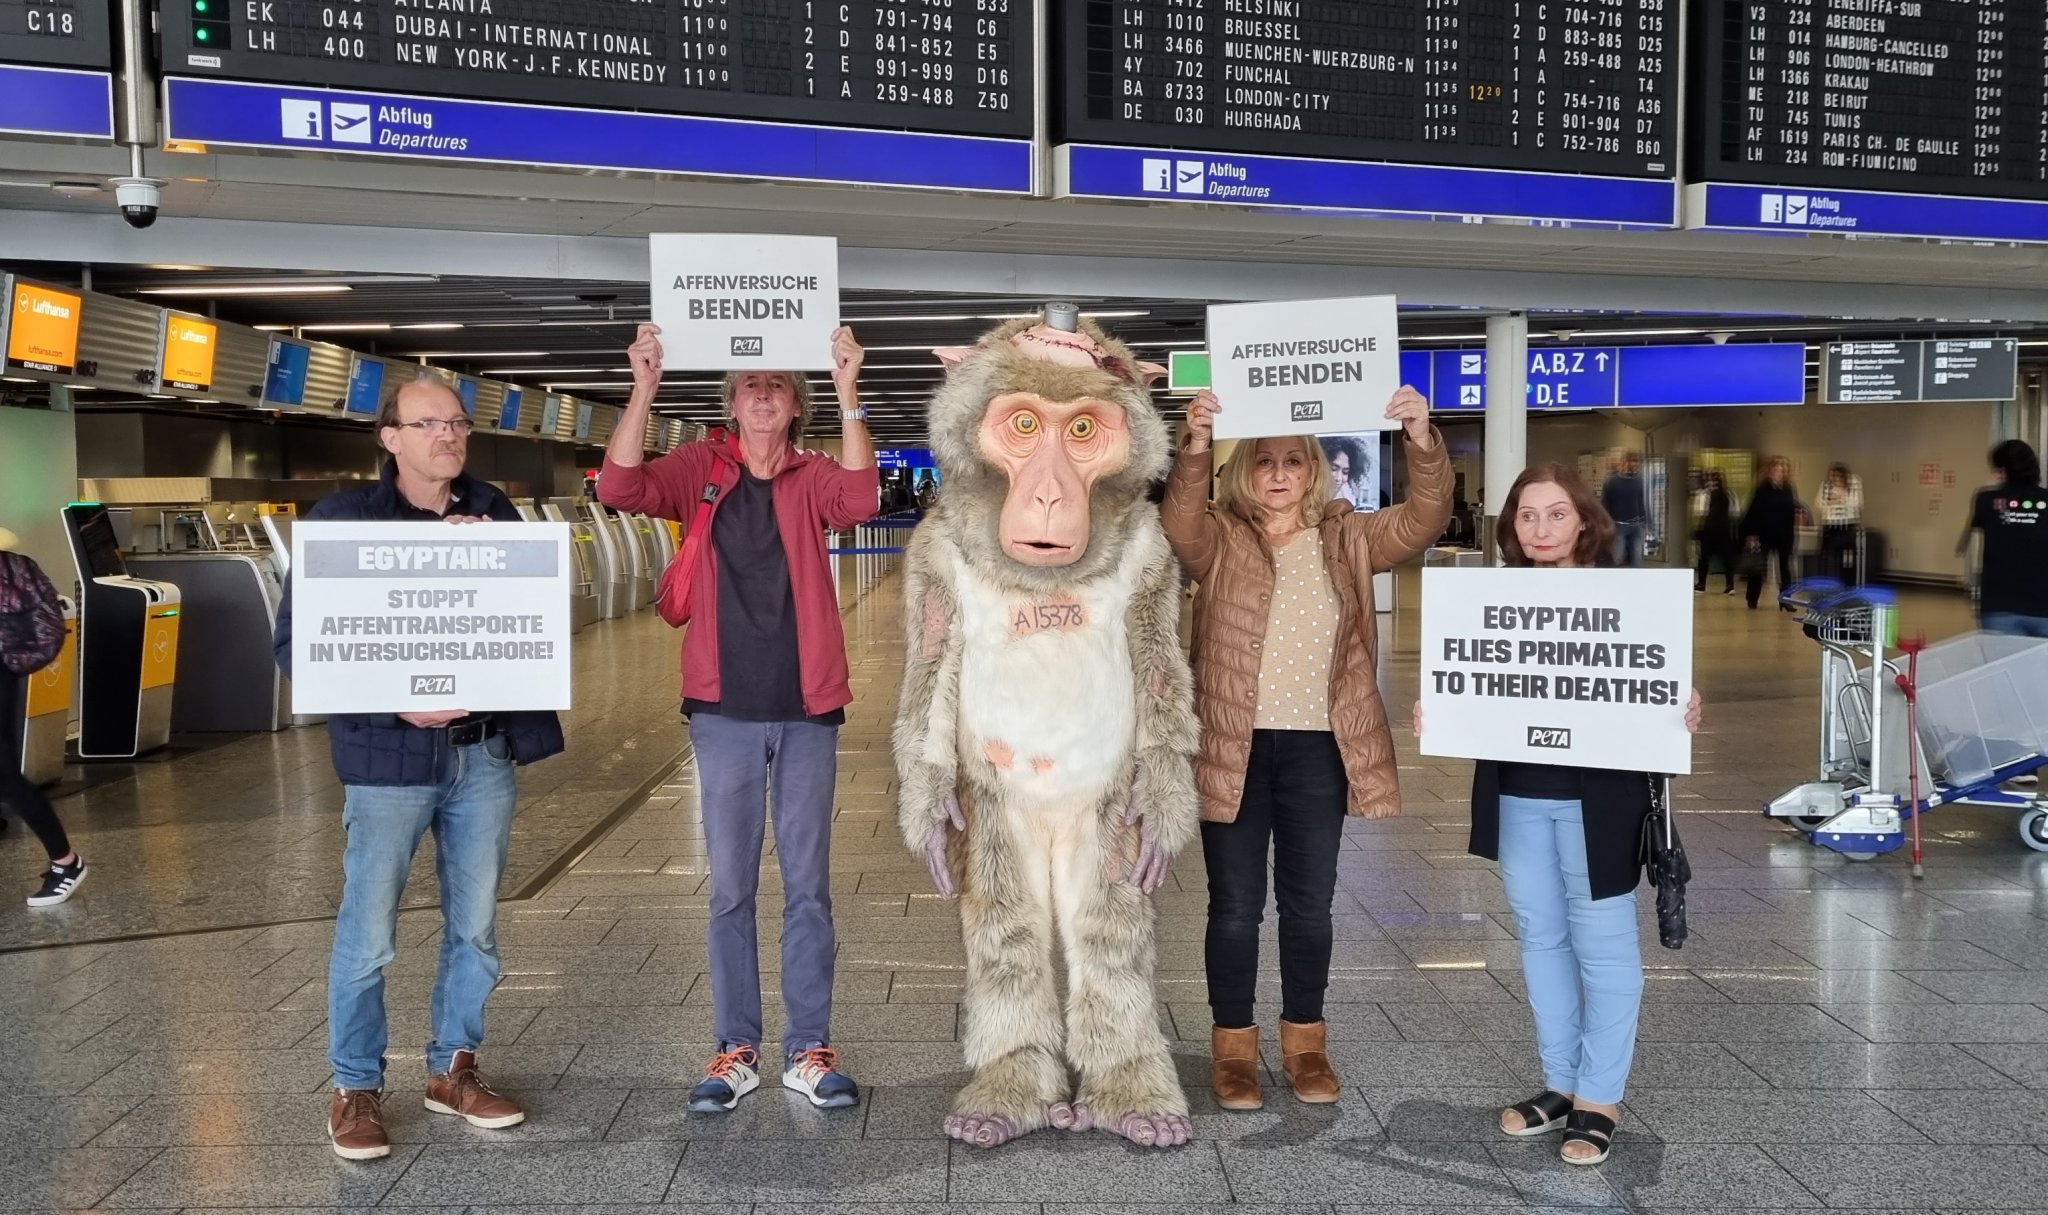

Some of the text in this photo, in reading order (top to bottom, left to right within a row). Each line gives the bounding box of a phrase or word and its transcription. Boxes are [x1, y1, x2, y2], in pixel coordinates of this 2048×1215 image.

[27, 10, 73, 34] C18
[839, 4, 849, 23] C
[875, 8, 953, 33] 791-794
[977, 18, 997, 37] C6
[1225, 0, 1300, 18] HELSINKI
[1513, 23, 1520, 39] 2
[1538, 26, 1546, 41] D
[1564, 28, 1622, 49] 883-885
[1638, 36, 1662, 53] D25
[1538, 4, 1547, 20] C
[1565, 7, 1622, 28] 704-716
[1639, 15, 1663, 32] C15
[1750, 5, 1766, 21] V3
[1789, 9, 1811, 25] 234
[1825, 14, 1885, 33] ABERDEEN
[246, 0, 274, 23] EK
[322, 7, 364, 30] 044
[805, 52, 814, 70] 2
[841, 55, 849, 73] E
[876, 58, 953, 82] 991-999
[977, 67, 1008, 86] D16
[804, 26, 814, 45] 2
[839, 29, 850, 48] D
[875, 33, 953, 57] 841-852
[977, 42, 997, 61] E5
[1124, 8, 1143, 26] LH
[1166, 13, 1204, 32] 1010
[1225, 18, 1301, 41] BRUESSEL
[1537, 47, 1546, 63] A
[1564, 50, 1621, 70] 259-488
[1638, 57, 1662, 73] A25
[1750, 26, 1766, 41] LH
[1788, 29, 1811, 45] 014
[1124, 32, 1143, 50] LH
[1165, 36, 1203, 55] 3466
[1537, 69, 1546, 84] A
[1638, 77, 1654, 93] T4
[1749, 46, 1765, 61] LH
[1788, 49, 1810, 66] 906
[248, 28, 275, 51] LH
[324, 36, 364, 58] 400
[396, 42, 438, 64] NEW
[841, 80, 852, 98] A
[876, 83, 953, 106] 259-488
[978, 91, 1008, 110] Z50
[1749, 66, 1765, 81] LH
[1781, 69, 1810, 86] 1366
[1824, 73, 1869, 91] KRAKAU
[1124, 56, 1143, 73] 4Y
[1175, 60, 1203, 78] 702
[1225, 64, 1292, 85] FUNCHAL
[1537, 90, 1545, 105] C
[1563, 92, 1620, 112] 754-716
[1637, 98, 1661, 115] A36
[1123, 79, 1144, 97] BA
[1165, 82, 1204, 101] 8733
[1511, 109, 1519, 125] 2
[1537, 111, 1544, 126] E
[1562, 113, 1620, 132] 901-904
[1637, 119, 1653, 134] D7
[1748, 86, 1764, 102] ME
[1787, 89, 1809, 105] 218
[1824, 92, 1868, 110] BEIRUT
[378, 106, 432, 129] Abflug
[1124, 102, 1143, 120] DE
[1175, 106, 1203, 124] 030
[1225, 110, 1301, 131] HURGHADA
[1536, 132, 1544, 148] C
[1563, 134, 1619, 153] 752-786
[1636, 139, 1660, 156] B60
[1748, 106, 1764, 122] TU
[1787, 109, 1809, 125] 745
[1824, 112, 1861, 129] TUNIS
[379, 129, 467, 150] Departures
[1747, 126, 1763, 141] AF
[1780, 129, 1809, 145] 1619
[1823, 132, 1860, 149] PARIS
[1896, 137, 1910, 152] DE
[1917, 139, 1959, 156] GAULLE
[1747, 147, 1763, 161] LH
[1786, 149, 1808, 164] 234
[1209, 163, 1246, 180] Abflug
[1209, 182, 1270, 198] Departures
[1809, 196, 1840, 212] Abflug
[1808, 213, 1858, 228] Departures
[673, 275, 818, 291] AFFENVERSUCHE
[33, 298, 70, 319] Lufthansa
[688, 298, 803, 320] BEENDEN
[1231, 337, 1377, 360] AFFENVERSUCHE
[1248, 360, 1363, 388] BEENDEN
[358, 546, 507, 570] EGYPTAIR:
[387, 589, 478, 609] STOPPT
[320, 615, 544, 635] AFFENTRANSPORTE
[1483, 605, 1621, 632] EGYPTAIR
[309, 641, 554, 662] IN VERSUCHSLABORE!
[1443, 638, 1666, 669] FLIES PRIMATES
[1431, 670, 1679, 706] TO THEIR DEATHS!
